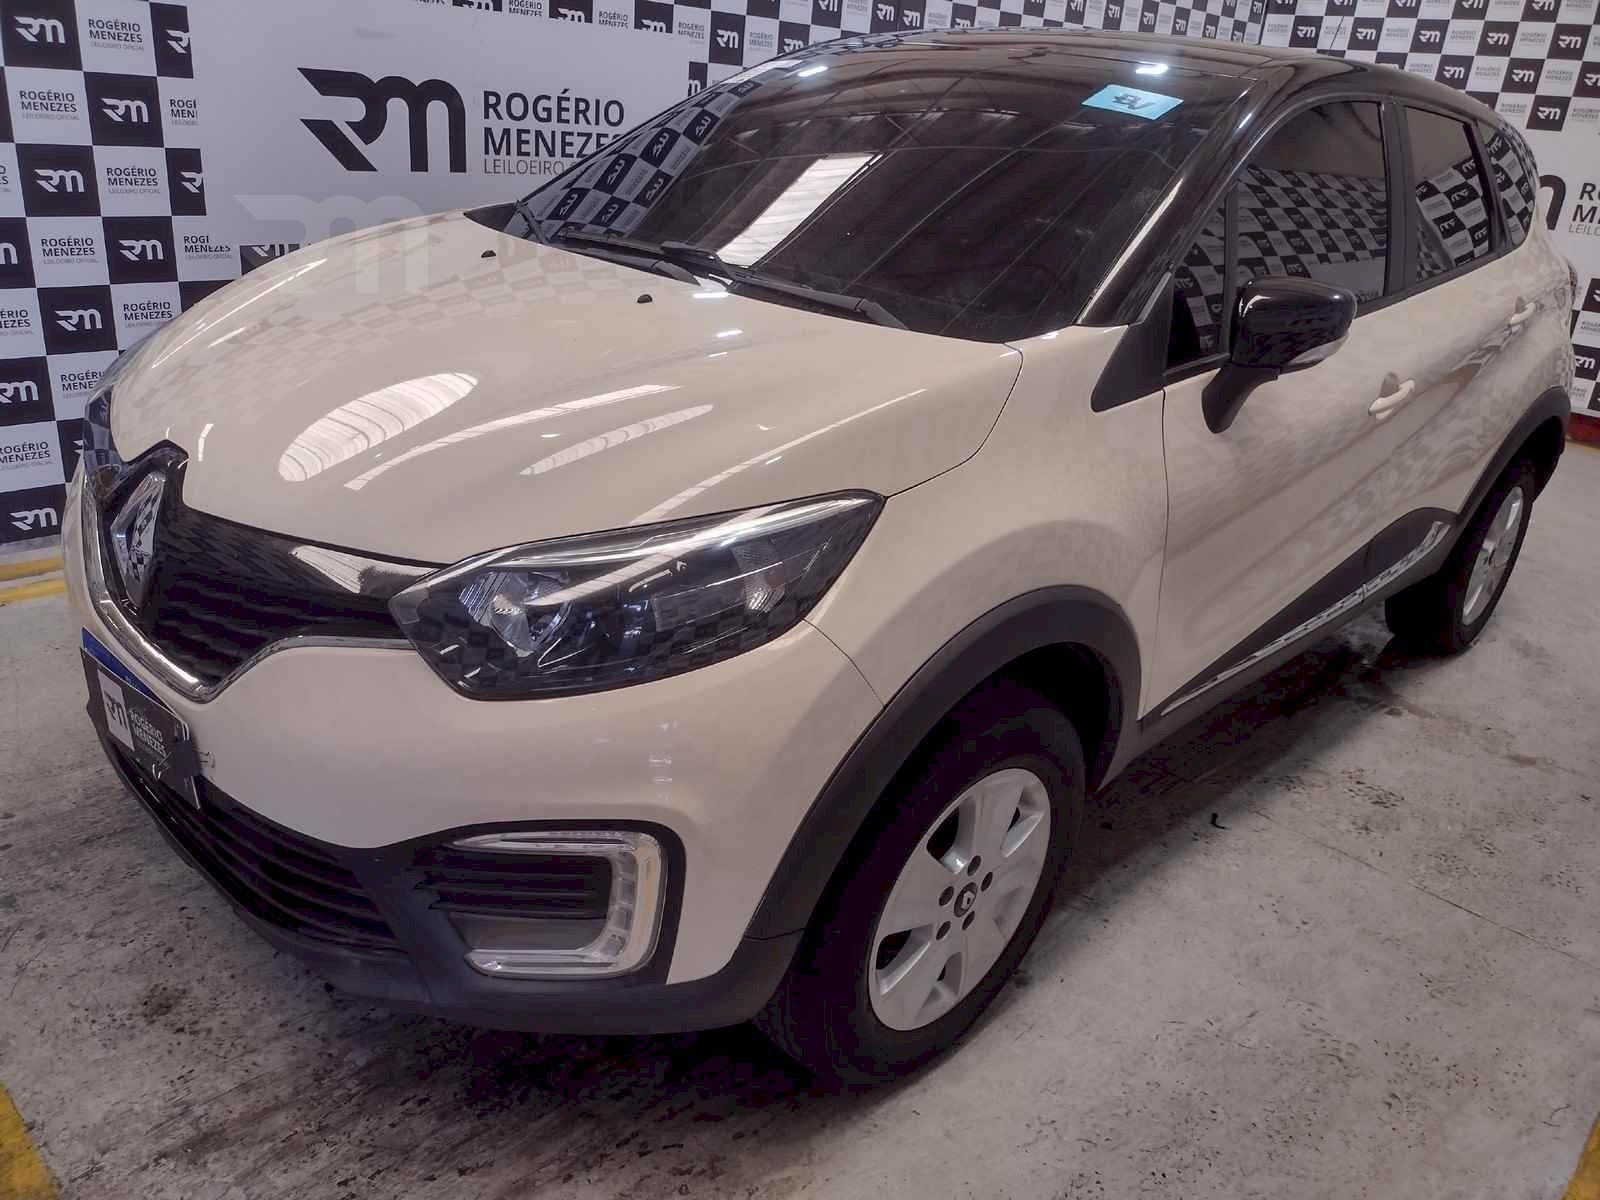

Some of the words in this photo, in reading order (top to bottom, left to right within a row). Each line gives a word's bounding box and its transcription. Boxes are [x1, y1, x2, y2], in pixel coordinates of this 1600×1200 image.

[88, 18, 140, 32] ROGÉRIO
[89, 30, 143, 43] MENEZES
[19, 89, 75, 102] ROGÉRIO
[21, 101, 78, 113] MENEZES
[484, 88, 625, 127] ROGÉRIO
[106, 165, 157, 177] ROGÉRIO
[484, 159, 564, 175] LEILOEIRO
[107, 177, 159, 187] MENEZES
[41, 236, 94, 247] ROGÉRIO
[42, 247, 95, 257] MENEZES
[123, 300, 170, 311] ROGÉRIO
[0, 308, 28, 319] ÉRIO
[124, 311, 173, 320] MENEZES
[0, 319, 31, 328] EZES
[62, 381, 97, 391] MENE
